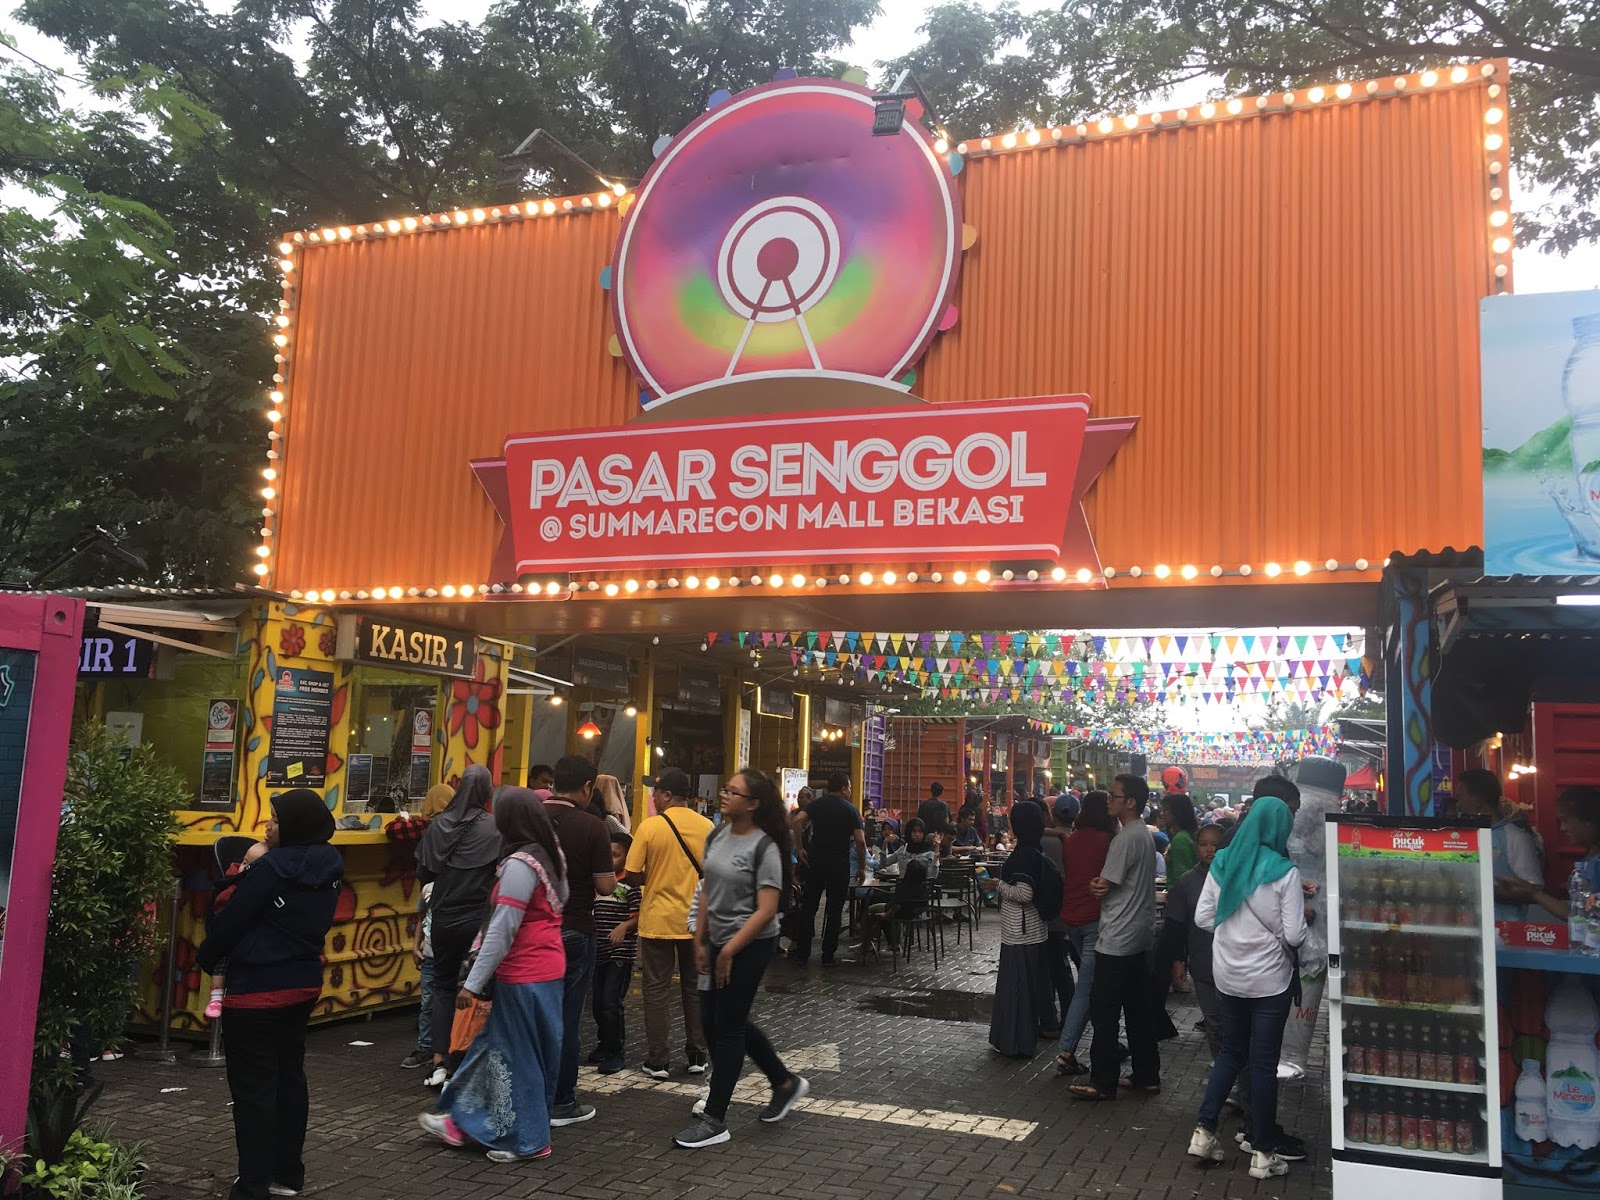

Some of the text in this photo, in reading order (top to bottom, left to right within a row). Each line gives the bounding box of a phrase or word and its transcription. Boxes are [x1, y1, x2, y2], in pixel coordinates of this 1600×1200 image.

[530, 431, 1047, 510] PASAR SENGGOL
[540, 495, 1025, 542] @ SUMMARECON MALL BEKASI
[78, 637, 137, 672] IR 1
[369, 624, 464, 670] KASIR 1
[1567, 1083, 1580, 1094] Le
